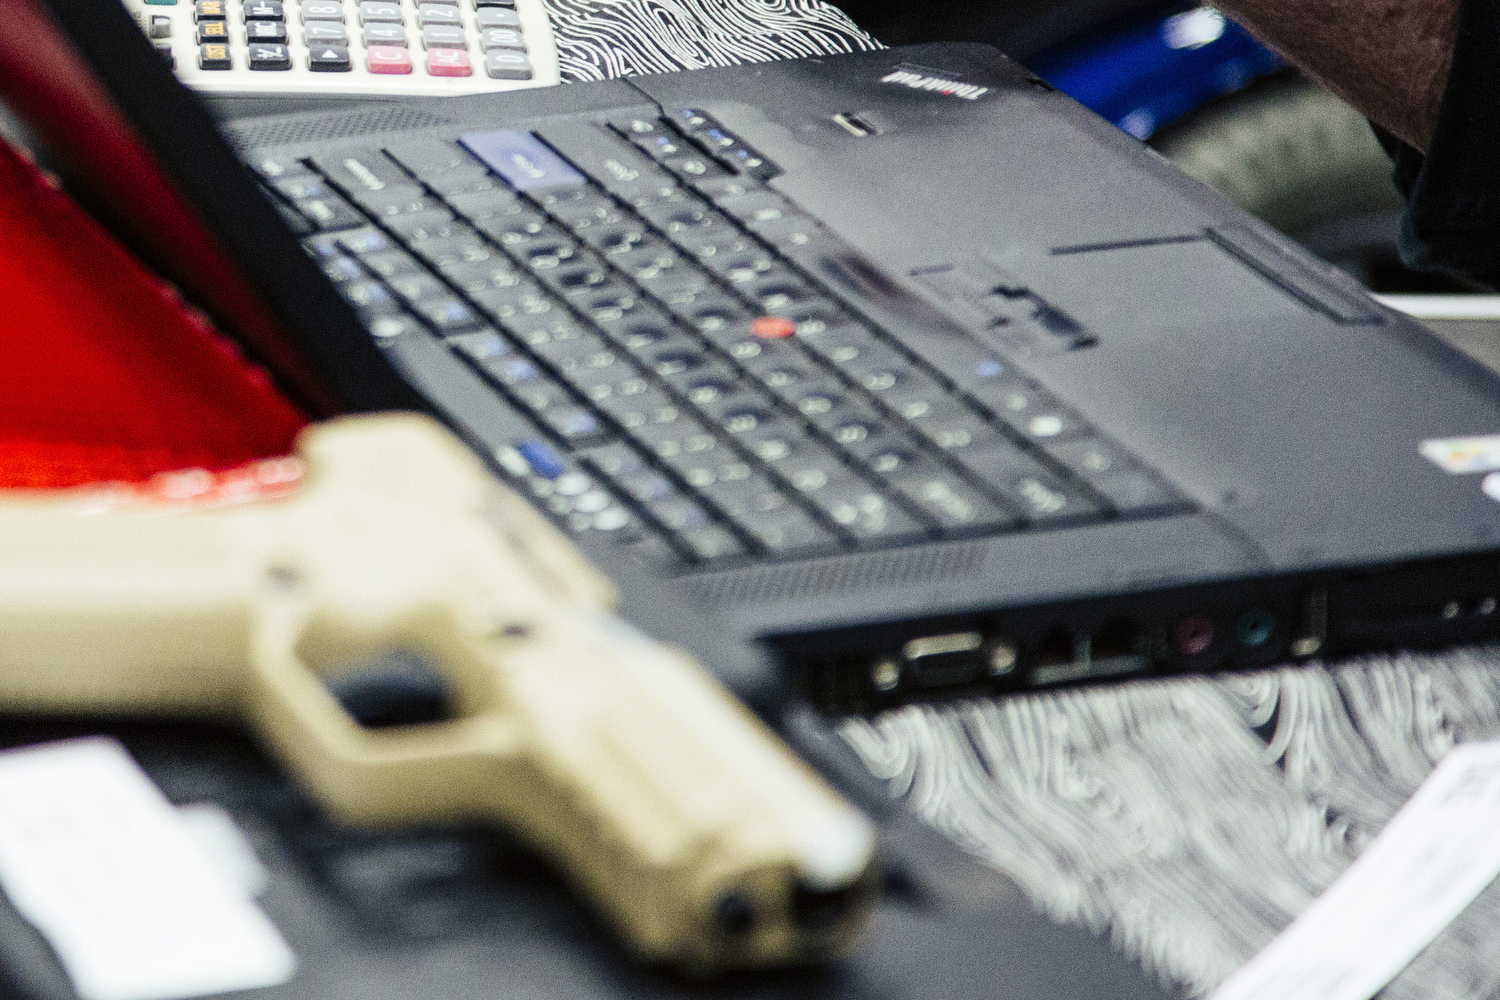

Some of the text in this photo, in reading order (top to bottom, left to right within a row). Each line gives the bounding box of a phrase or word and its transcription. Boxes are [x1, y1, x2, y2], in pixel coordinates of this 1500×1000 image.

[367, 7, 396, 15] 5
[425, 9, 453, 18] 2
[369, 28, 398, 37] 4
[488, 30, 518, 43] 00
[374, 51, 402, 61] C
[437, 49, 460, 64] AC
[494, 54, 525, 64] 0
